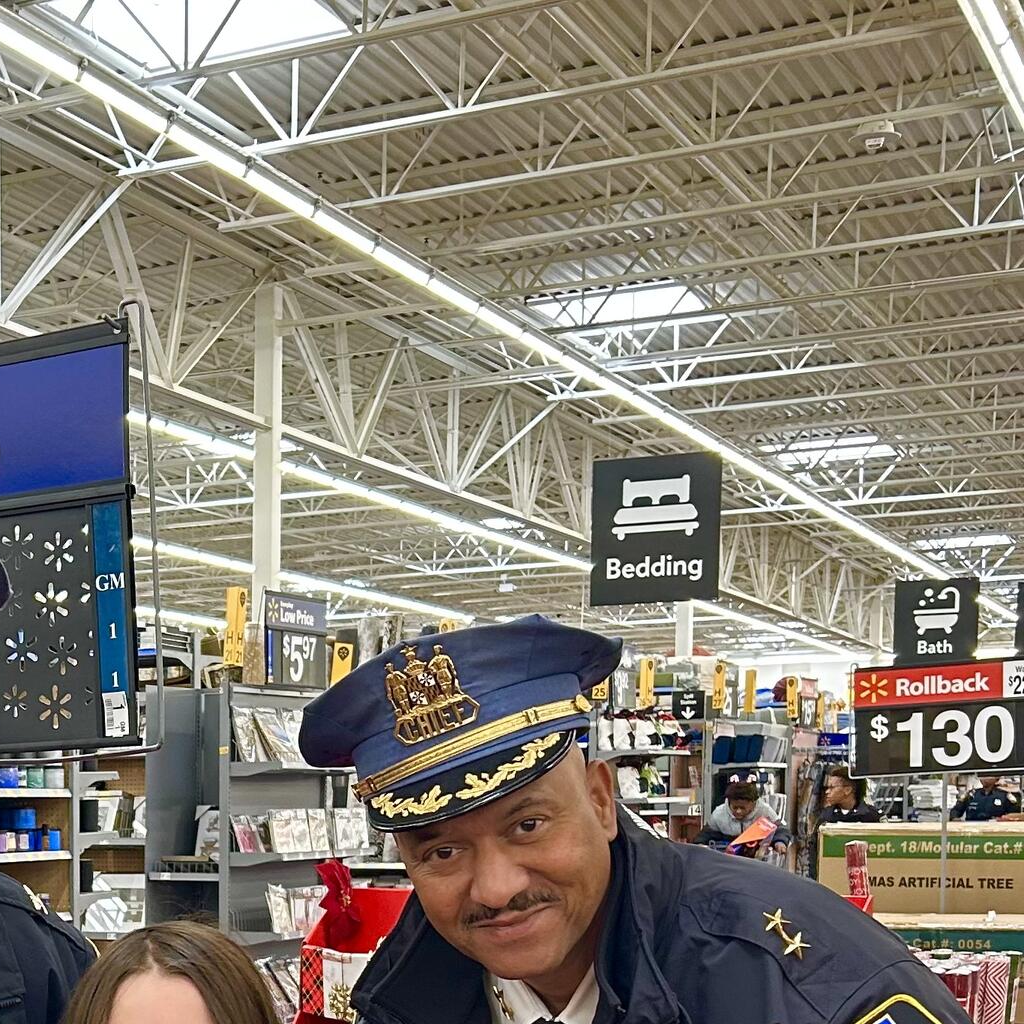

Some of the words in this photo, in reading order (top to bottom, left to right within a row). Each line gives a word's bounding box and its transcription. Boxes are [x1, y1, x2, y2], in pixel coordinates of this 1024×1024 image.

[606, 555, 704, 582] Bedding
[95, 572, 125, 591] GM
[280, 608, 295, 624] Low
[297, 610, 314, 626] Price
[109, 623, 118, 639] 1
[917, 640, 953, 654] Bath
[111, 672, 119, 688] 1
[895, 672, 990, 697] Rollback
[593, 688, 606, 697] 25
[402, 701, 466, 739] CHIEF
[870, 705, 1015, 768] $130
[867, 843, 895, 856] ept.
[898, 877, 974, 890] ARTIFICIAL
[977, 878, 1014, 890] TREE
[958, 939, 991, 950] 0054
